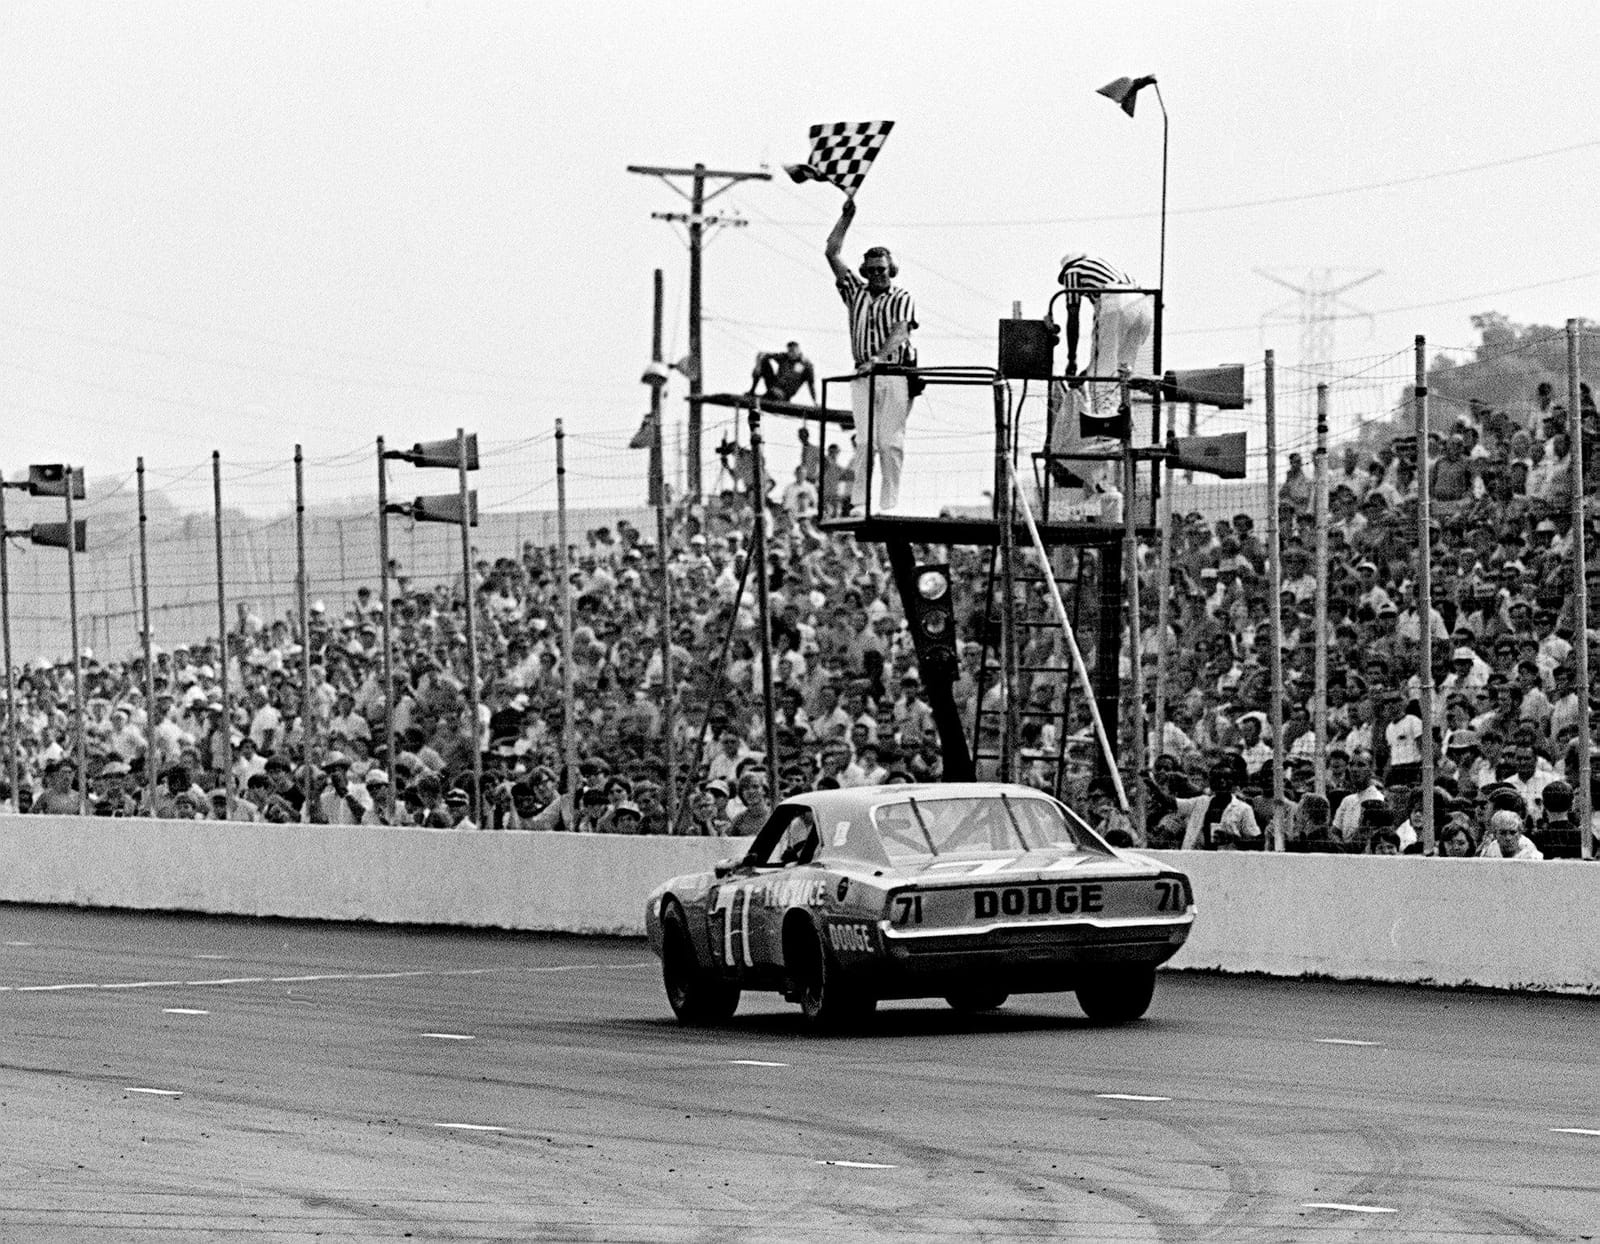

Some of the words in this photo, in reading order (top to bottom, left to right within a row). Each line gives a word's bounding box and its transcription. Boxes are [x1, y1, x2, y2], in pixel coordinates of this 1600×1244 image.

[896, 895, 922, 925] 71
[974, 884, 1104, 919] DODGE
[1154, 881, 1182, 912] 71
[829, 923, 874, 953] DODGE
